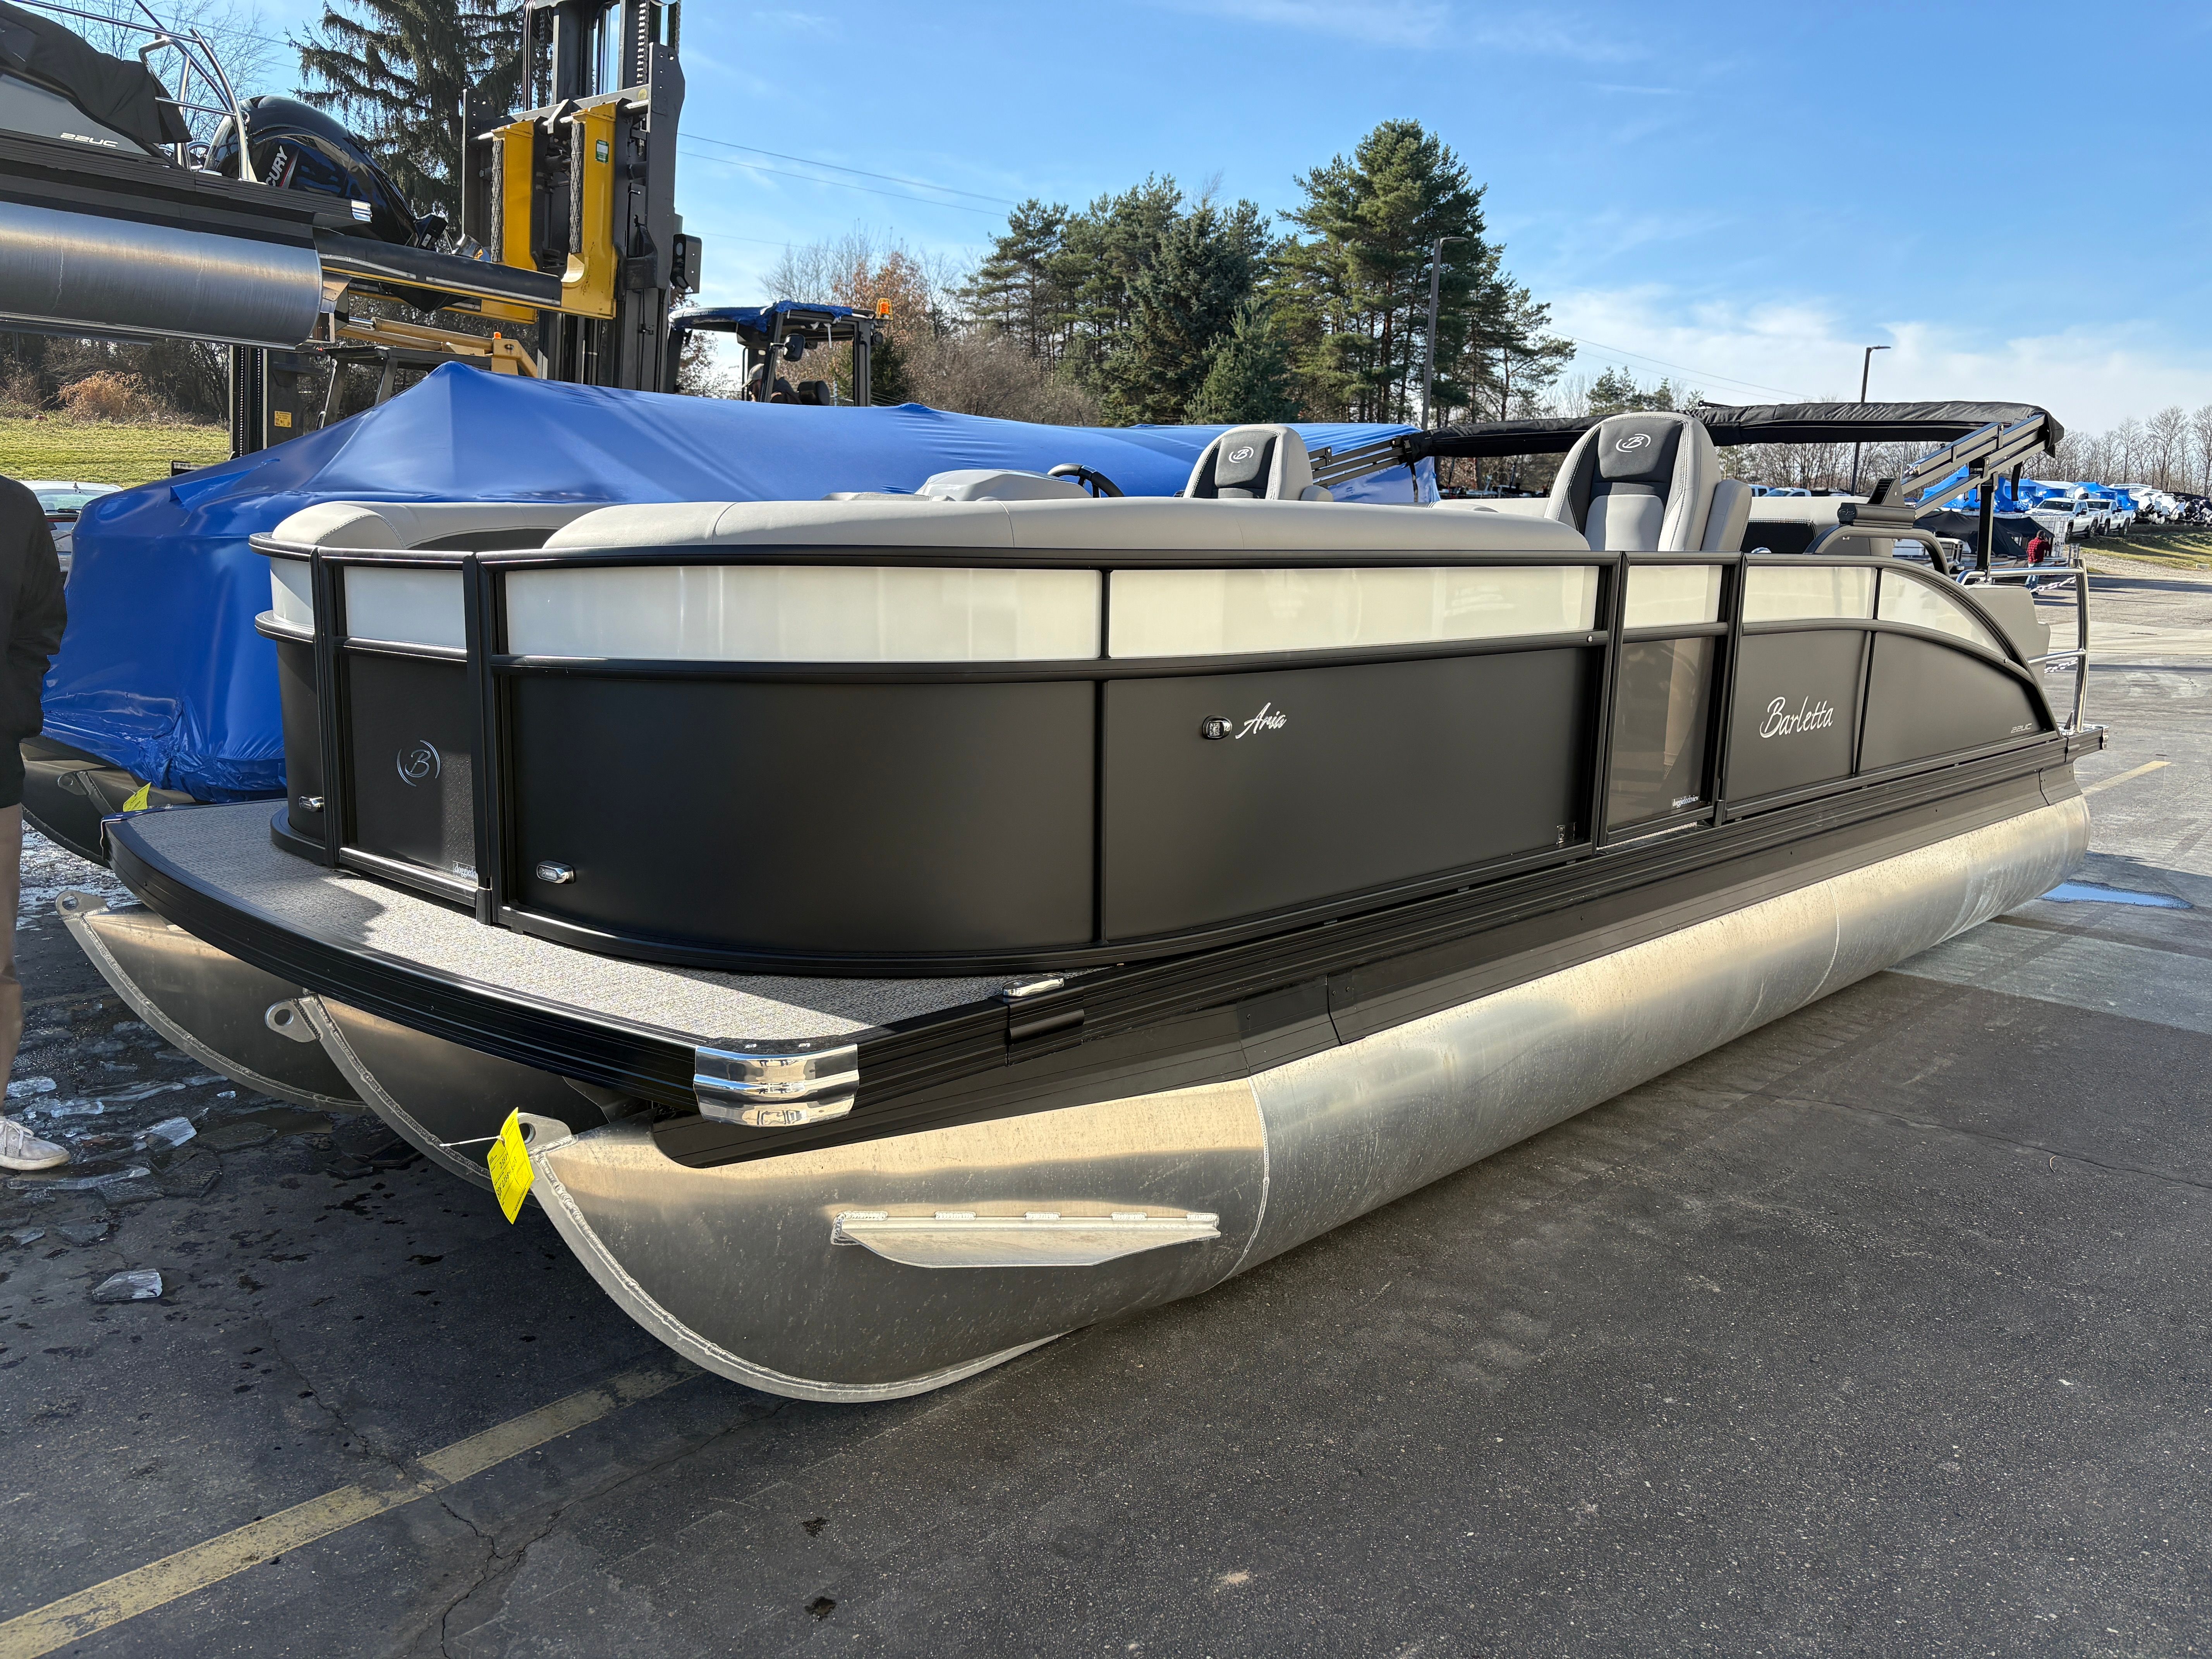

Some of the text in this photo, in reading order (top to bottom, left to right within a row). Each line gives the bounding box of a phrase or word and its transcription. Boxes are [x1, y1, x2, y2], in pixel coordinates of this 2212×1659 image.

[60, 132, 118, 147] 22UC
[1235, 702, 1287, 739] Aria
[1759, 695, 1834, 738] Barletta
[2011, 723, 2032, 733] 22UC
